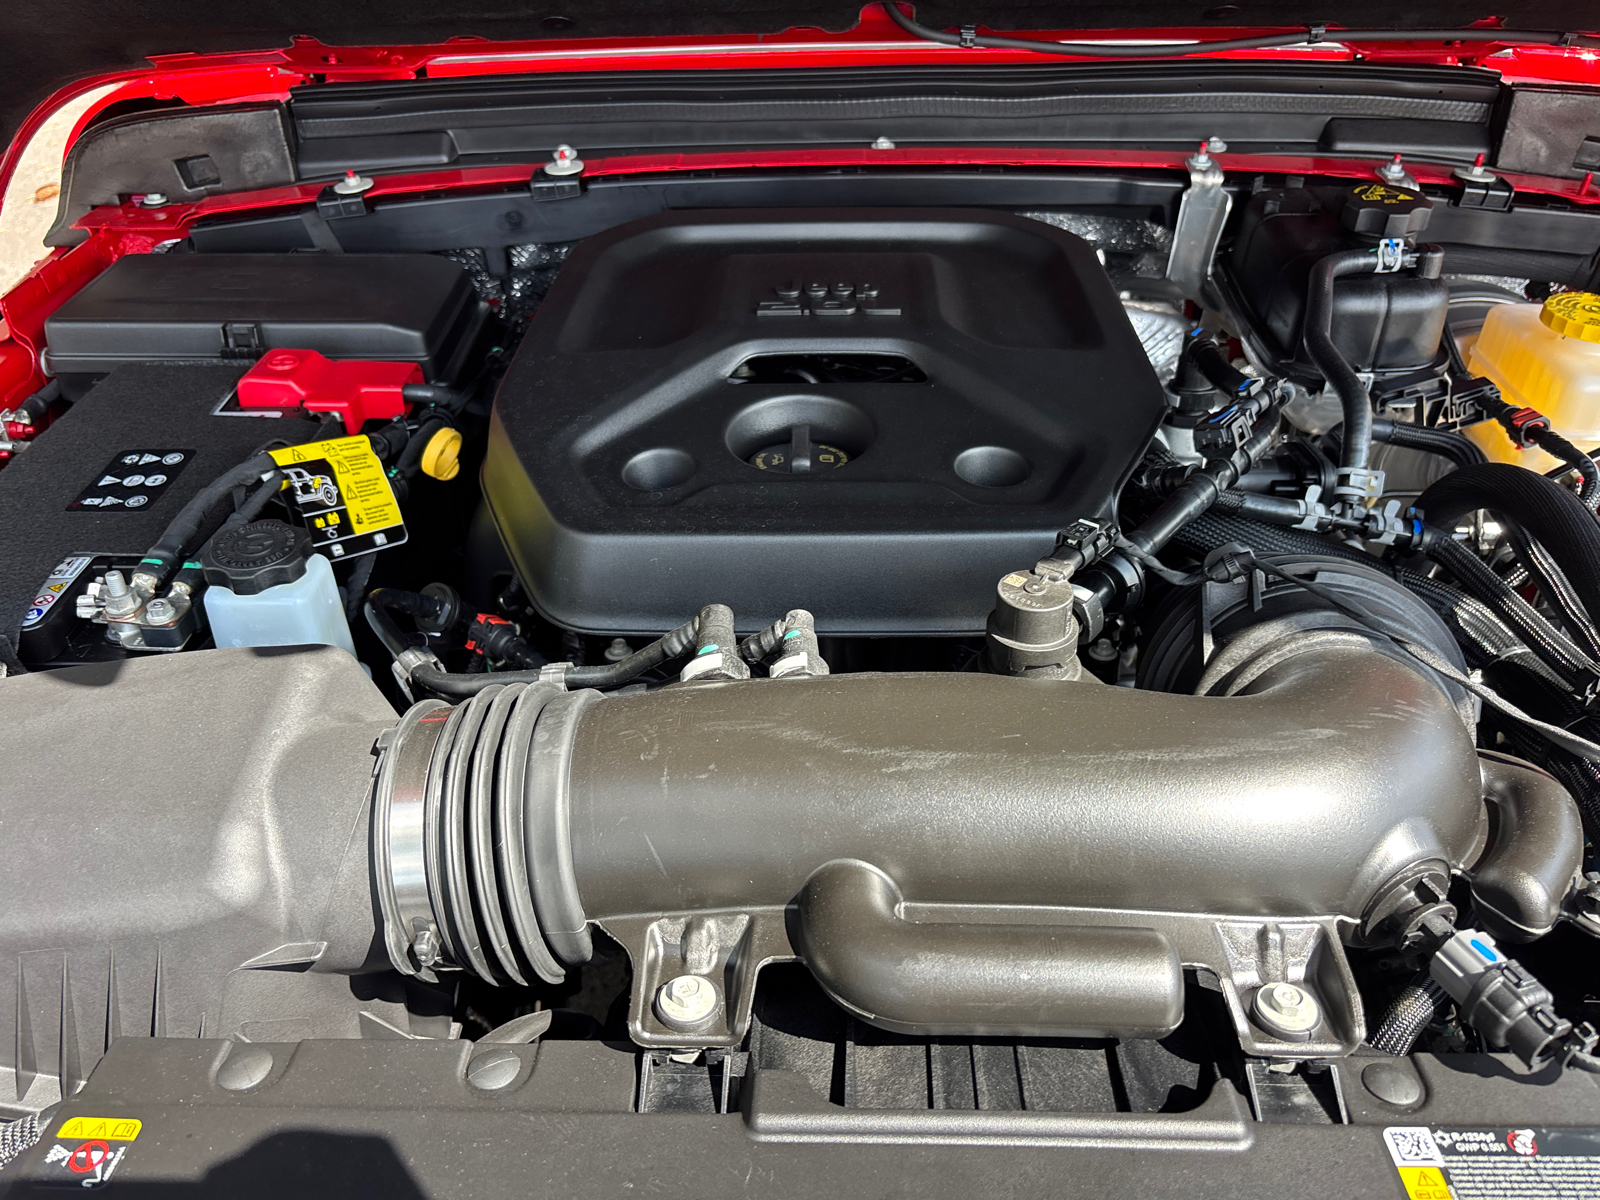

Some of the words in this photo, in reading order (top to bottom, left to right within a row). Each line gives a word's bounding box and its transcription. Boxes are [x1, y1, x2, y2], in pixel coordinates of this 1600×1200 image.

[775, 279, 881, 299] Jeep
[757, 300, 901, 316] 2.0L
[1455, 1142, 1480, 1152] GWP
